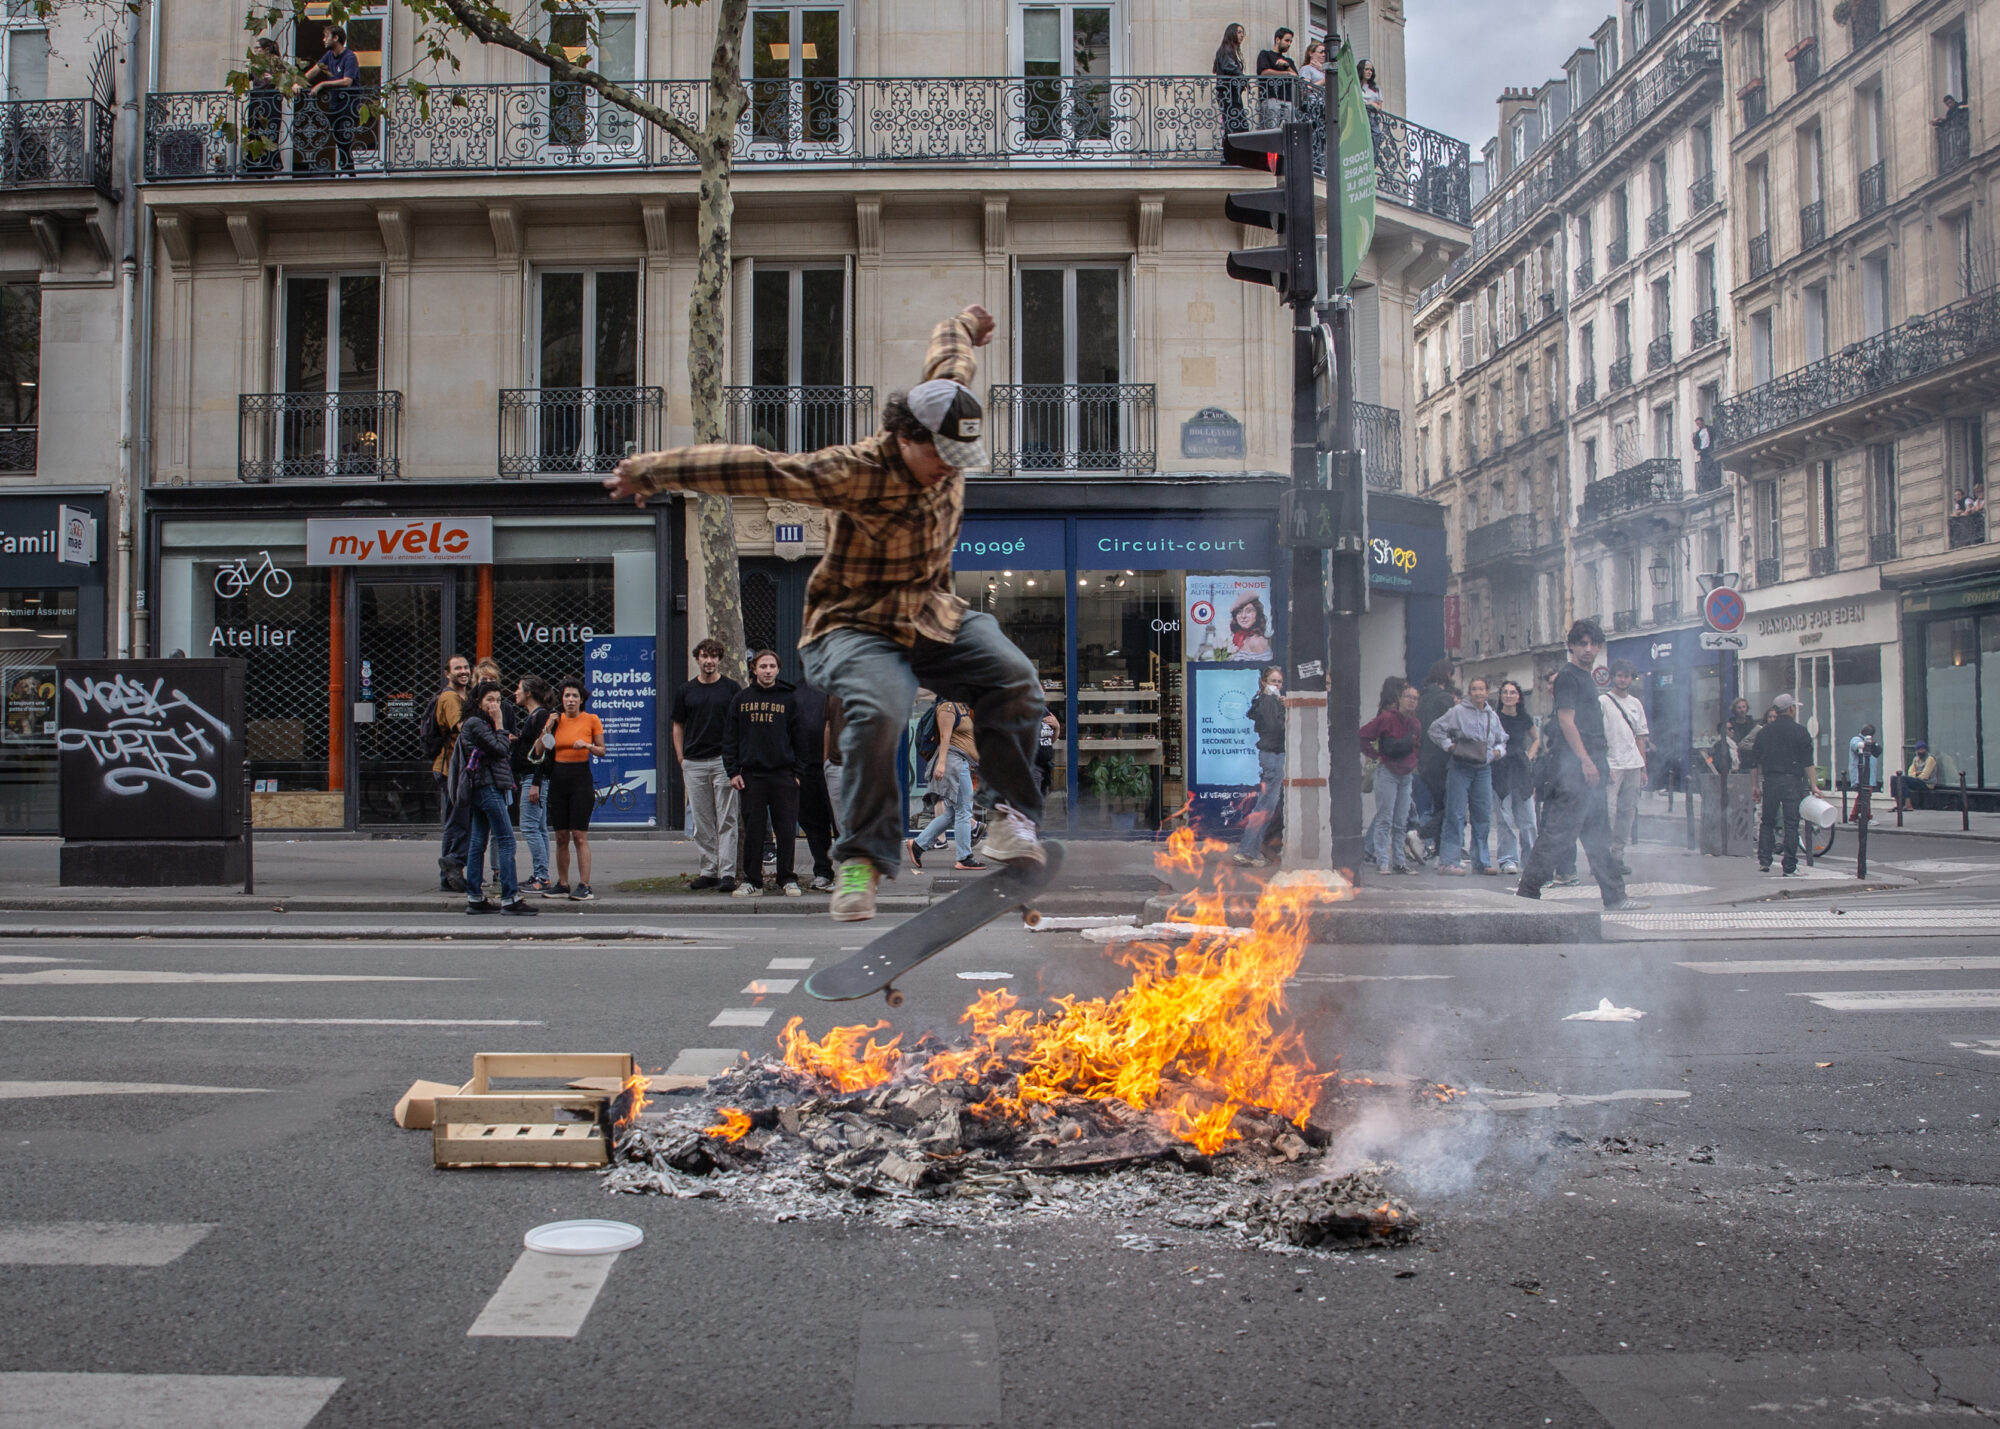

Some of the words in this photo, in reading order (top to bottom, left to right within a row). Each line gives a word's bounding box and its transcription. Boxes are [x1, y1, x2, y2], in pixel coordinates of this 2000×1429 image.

[0, 530, 55, 553] amil
[952, 537, 1026, 555] ngagé
[1098, 538, 1246, 552] Circuit-court
[1234, 581, 1267, 589] MONDE
[37, 607, 76, 616] Assureur
[1759, 614, 1807, 636] DIAMOND
[1807, 608, 1832, 629] FOR
[1834, 604, 1865, 625] EDEN
[209, 624, 297, 647] Atelier
[516, 621, 594, 643] Vente
[592, 669, 652, 687] Reprise
[592, 687, 601, 697] de
[608, 688, 634, 697] votre
[592, 699, 645, 710] électrique
[740, 702, 759, 712] FEAR
[760, 701, 769, 711] OF
[771, 703, 785, 713] GOD
[750, 712, 774, 722] STATE
